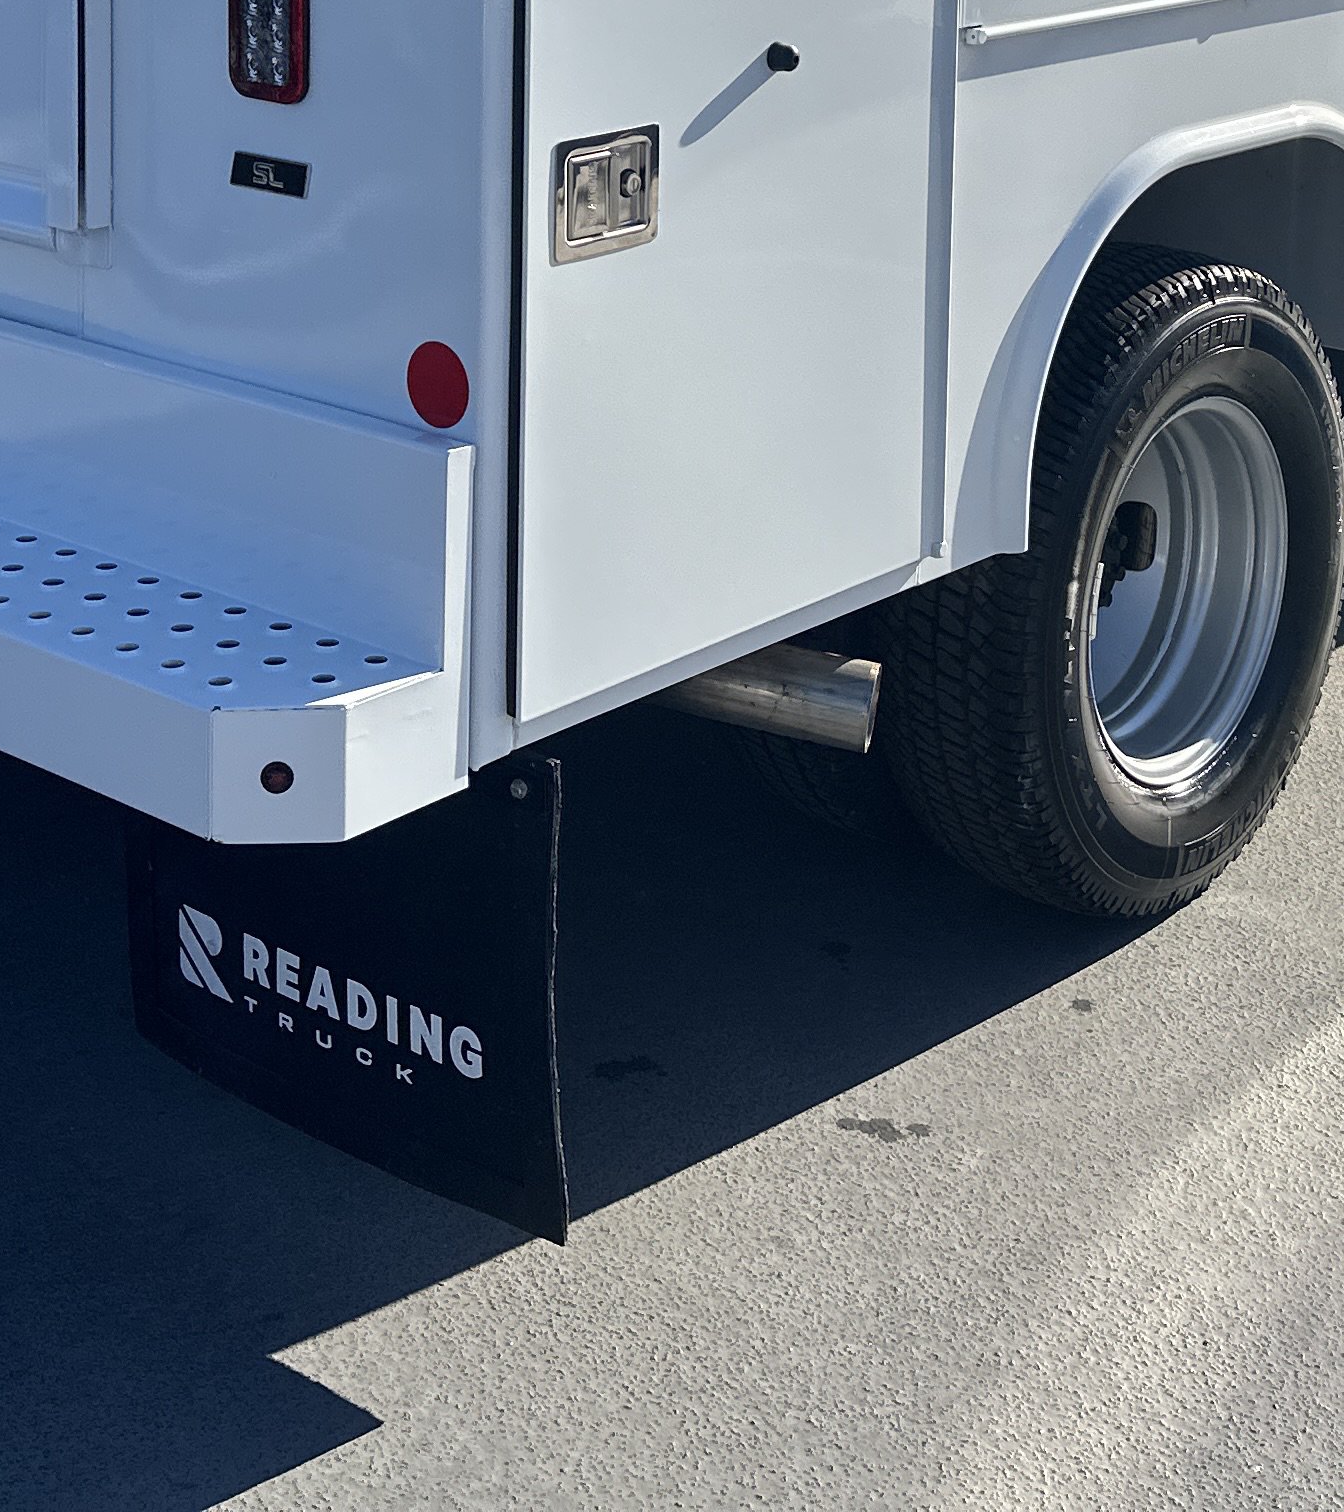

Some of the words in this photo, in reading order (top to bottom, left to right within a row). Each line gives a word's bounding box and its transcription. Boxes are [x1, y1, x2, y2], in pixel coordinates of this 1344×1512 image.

[252, 161, 284, 189] SL
[1142, 317, 1246, 409] MICHELIN
[242, 932, 484, 1080] READING
[243, 995, 414, 1086] TRUCK
